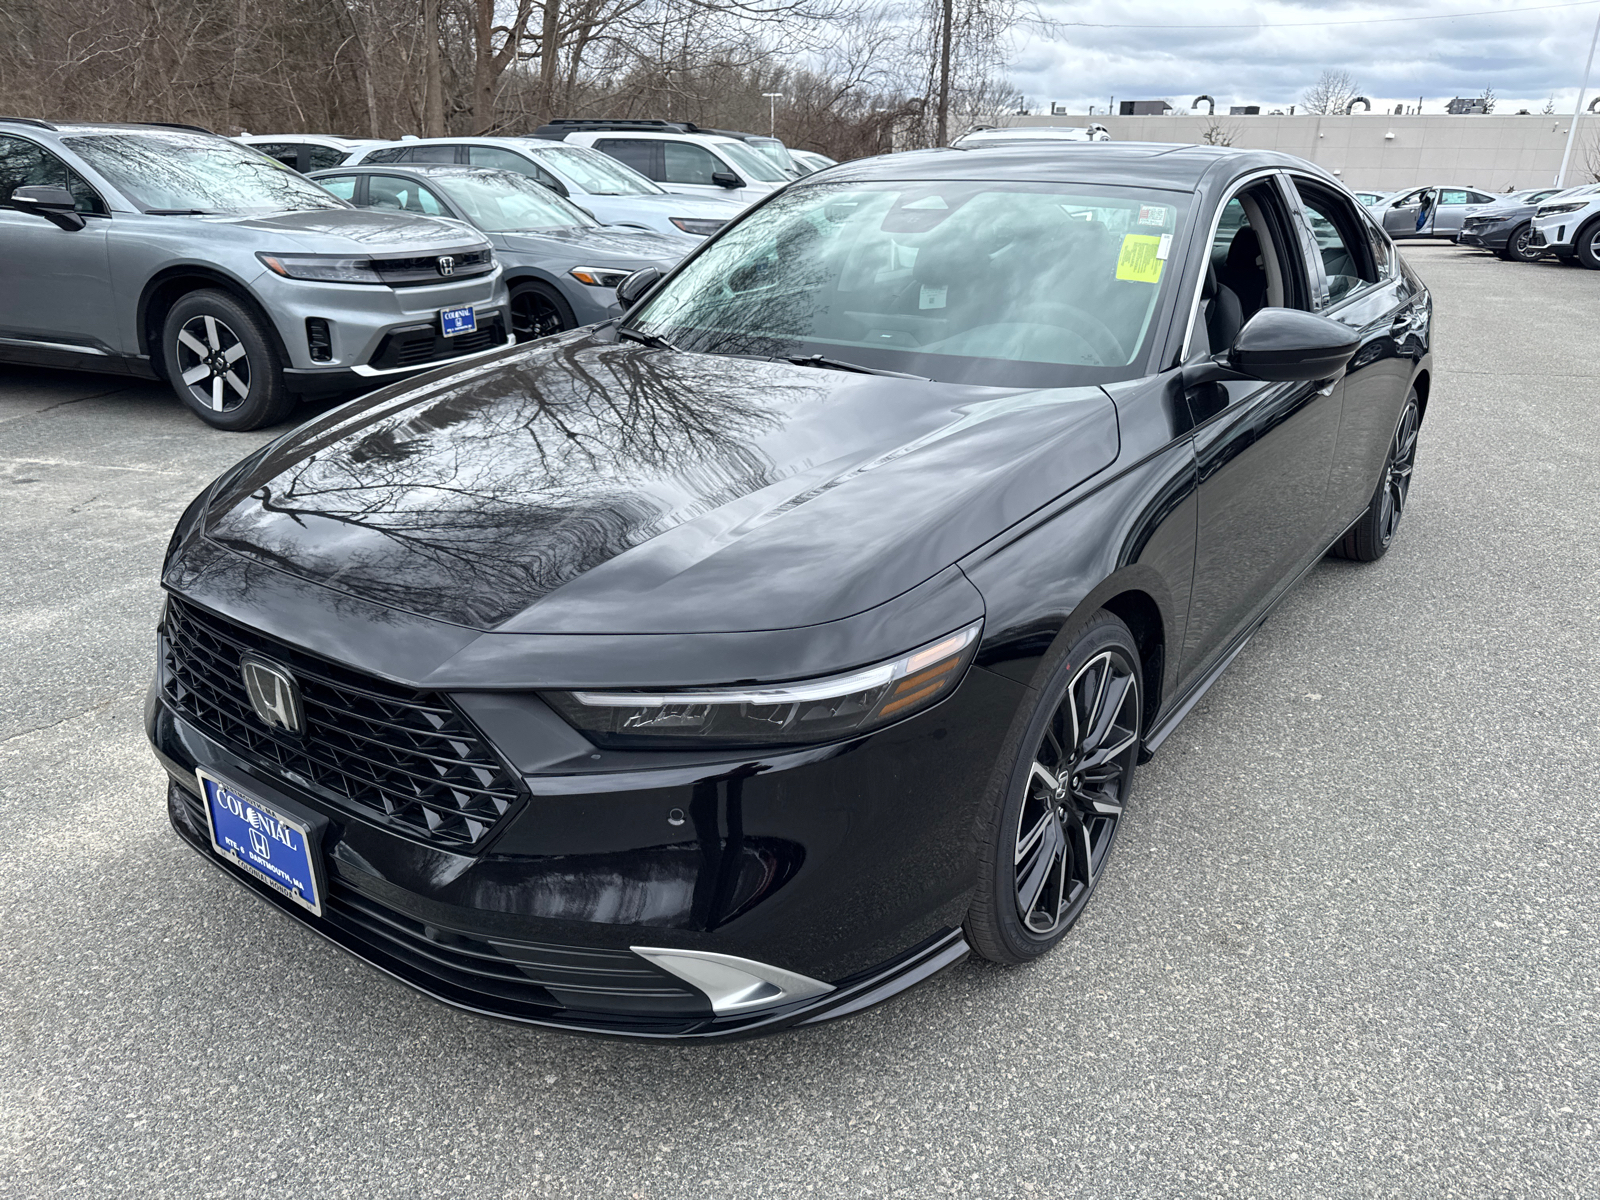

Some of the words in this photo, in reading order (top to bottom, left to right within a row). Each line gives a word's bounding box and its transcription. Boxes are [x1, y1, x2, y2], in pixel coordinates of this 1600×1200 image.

[216, 789, 297, 851] COLONIAL
[237, 859, 269, 884] COLONIAL
[269, 880, 294, 899] HONDA
[249, 852, 292, 884] DARTMOUTH,
[292, 878, 304, 891] MA
